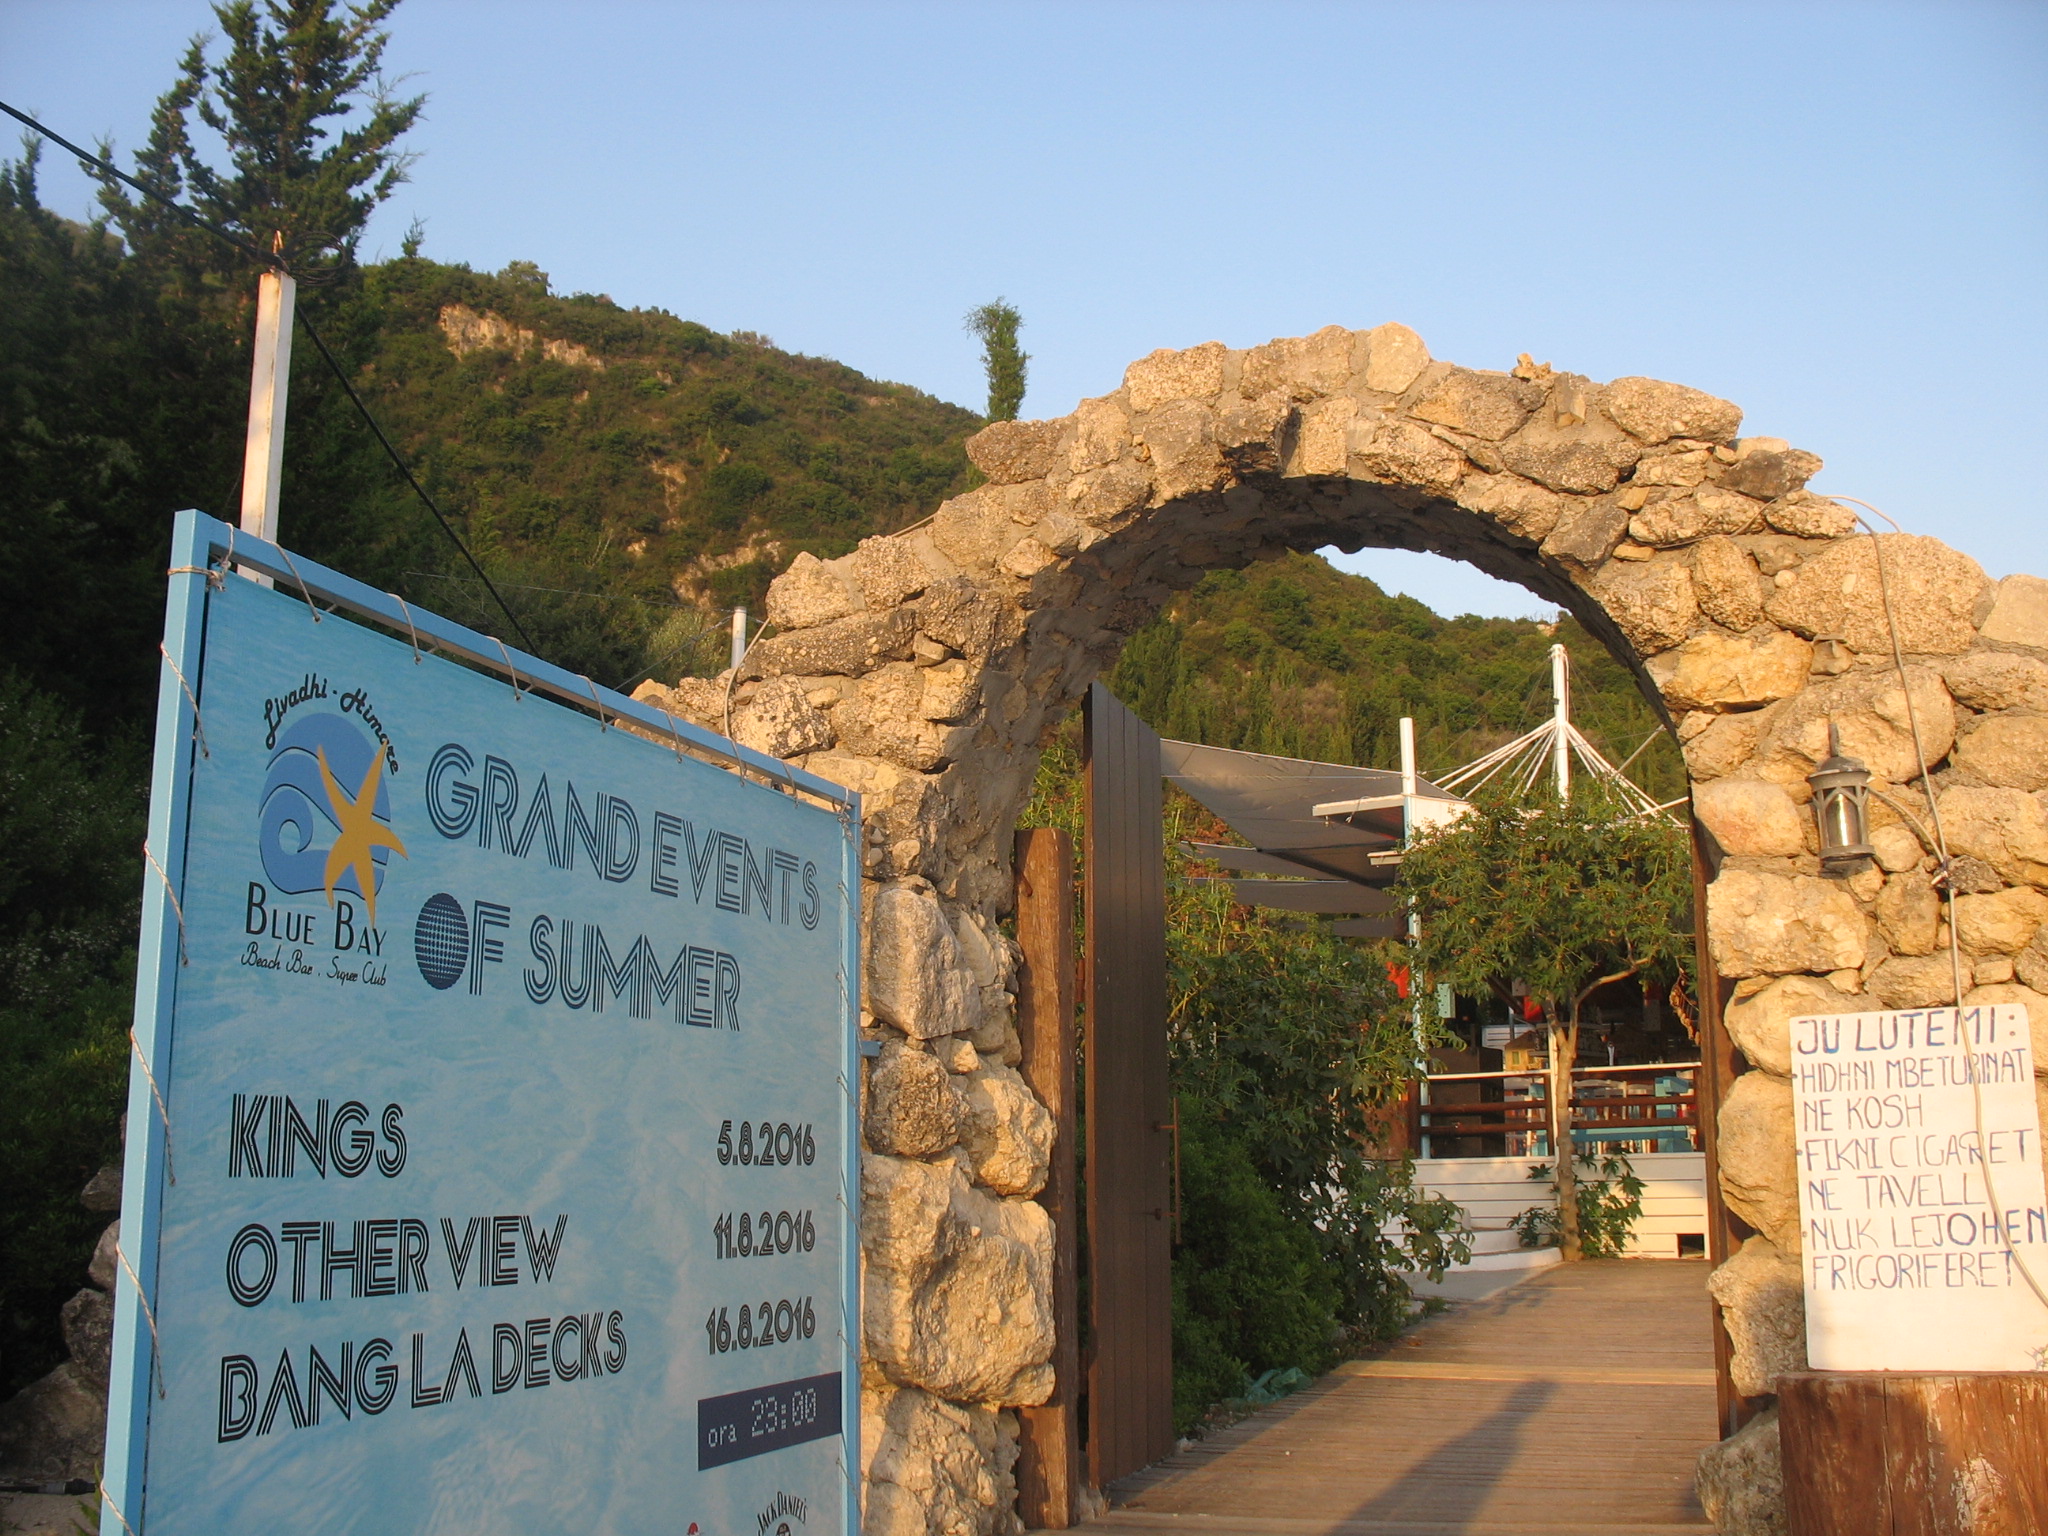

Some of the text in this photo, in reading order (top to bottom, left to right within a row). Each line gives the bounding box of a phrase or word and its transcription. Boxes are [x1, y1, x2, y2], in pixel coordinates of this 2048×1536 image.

[425, 742, 821, 931] GRAND EVENTS
[245, 881, 388, 957] BLUE BAY
[240, 941, 282, 970] Beach
[362, 961, 388, 987] Club
[413, 892, 741, 1033] OF SUMMER
[1797, 1018, 1841, 1055] JU
[1800, 1048, 2027, 1094] HIDHNI MBETURINAT
[227, 1092, 408, 1180] KINGS
[1803, 1093, 1924, 1132] NE KOSH
[716, 1120, 816, 1167] 5.8.2016
[1804, 1128, 2034, 1171] FIKNI CIGARET
[1808, 1172, 1988, 1212] NE TAVELL
[713, 1209, 816, 1260] 11.8.2016
[1811, 1206, 2047, 1251] NUK LEJOHEN
[225, 1213, 569, 1308] OTHER VIEW
[1812, 1249, 2016, 1291] FRIGORIFERET
[705, 1296, 816, 1356] 16.8.2016
[217, 1309, 628, 1444] BANG LA DECKS
[707, 1387, 817, 1448] ora 23:00
[756, 1499, 778, 1536] JACK
